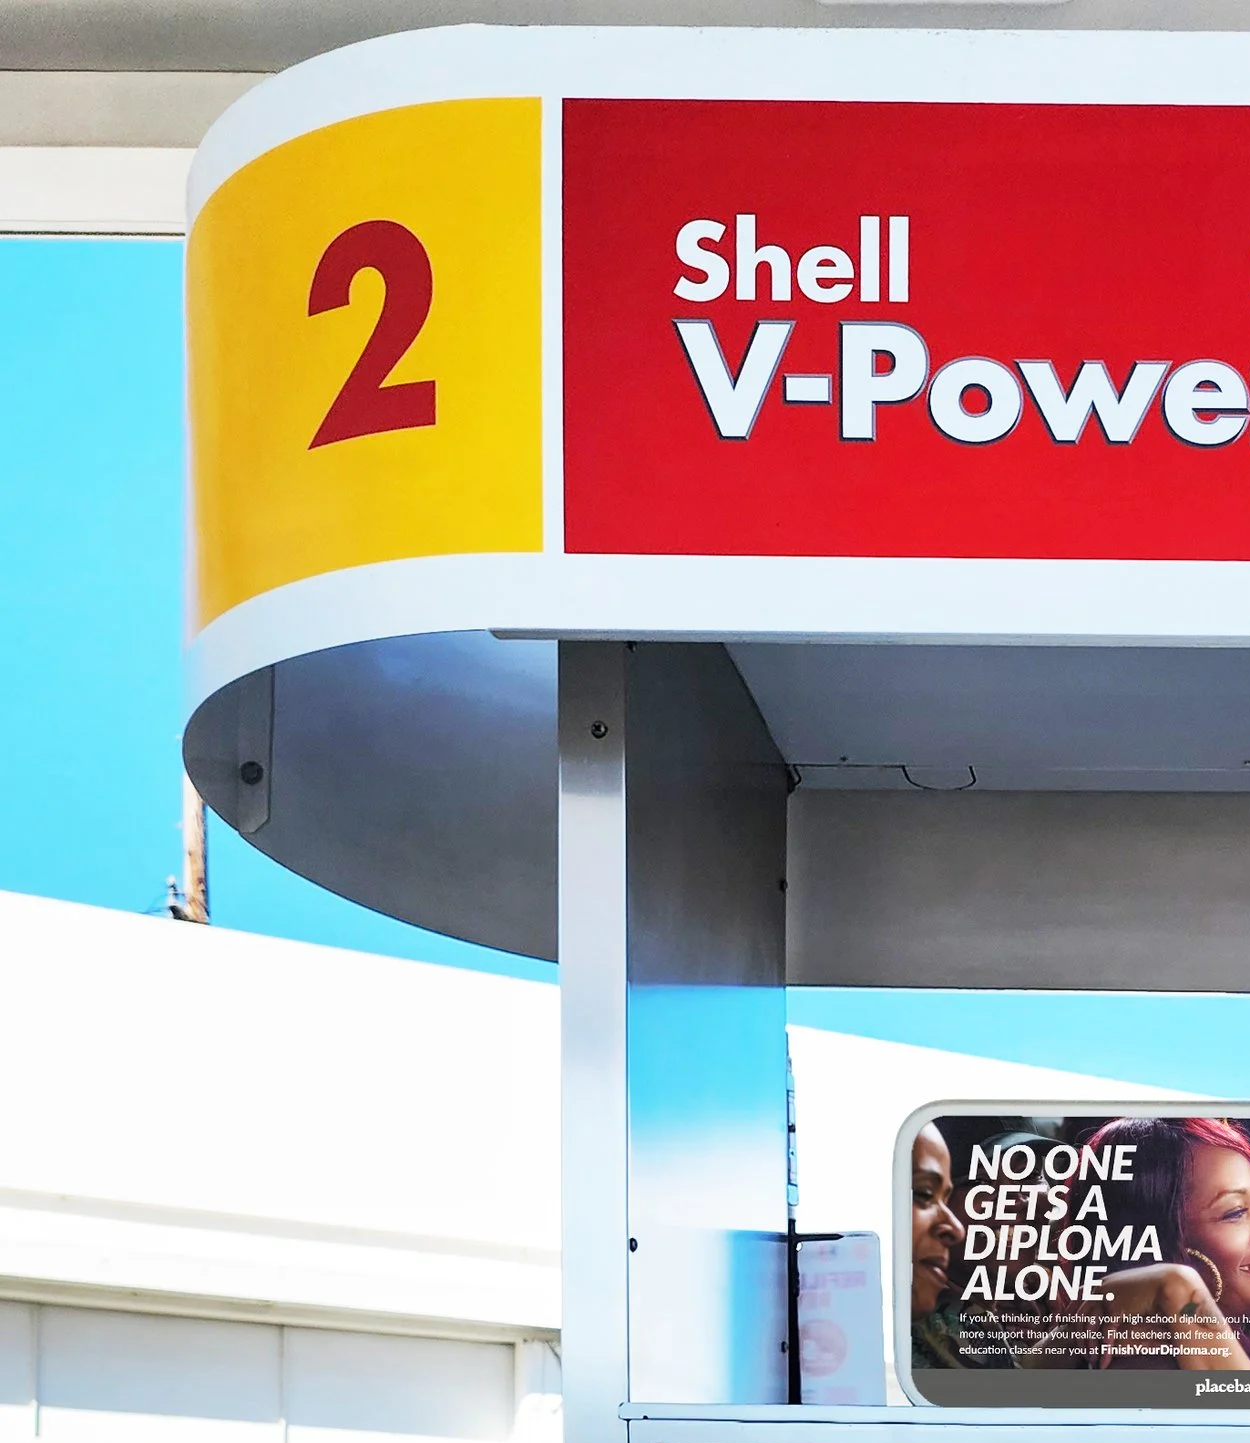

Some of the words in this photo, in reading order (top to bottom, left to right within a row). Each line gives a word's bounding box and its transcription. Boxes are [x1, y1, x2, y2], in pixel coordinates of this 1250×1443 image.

[673, 214, 910, 303] Shell
[307, 219, 437, 451] 2
[968, 1144, 1035, 1182] NO
[1043, 1144, 1138, 1181] ONE
[965, 1184, 1067, 1221] GETS
[1076, 1184, 1108, 1221] A
[962, 1224, 1163, 1261] DIPLOMA
[960, 1265, 1115, 1302] ALONE.
[959, 1313, 968, 1324] If
[969, 1313, 999, 1327] you're
[1001, 1313, 1040, 1327] thinking
[1043, 1313, 1053, 1324] of
[1055, 1313, 1096, 1327] finishing
[1098, 1316, 1121, 1327] your
[1122, 1313, 1144, 1327] high
[1146, 1313, 1177, 1324] school
[1179, 1313, 1220, 1327] diploma,
[1222, 1316, 1240, 1327] you
[959, 1332, 985, 1340] more
[987, 1330, 1024, 1343] support
[1026, 1329, 1049, 1340] than
[1050, 1332, 1068, 1343] you
[1071, 1329, 1104, 1340] realize.
[1107, 1329, 1128, 1340] Find
[1130, 1329, 1171, 1340] teachers
[1173, 1329, 1192, 1340] and
[1194, 1329, 1217, 1340] free
[1218, 1329, 1241, 1340] adult
[959, 1345, 1006, 1356] education
[1009, 1345, 1042, 1356] classes
[1045, 1347, 1067, 1356] near
[1069, 1347, 1087, 1358] you
[1088, 1346, 1099, 1356] at
[1101, 1344, 1232, 1359] FinishYourDiploma.org.
